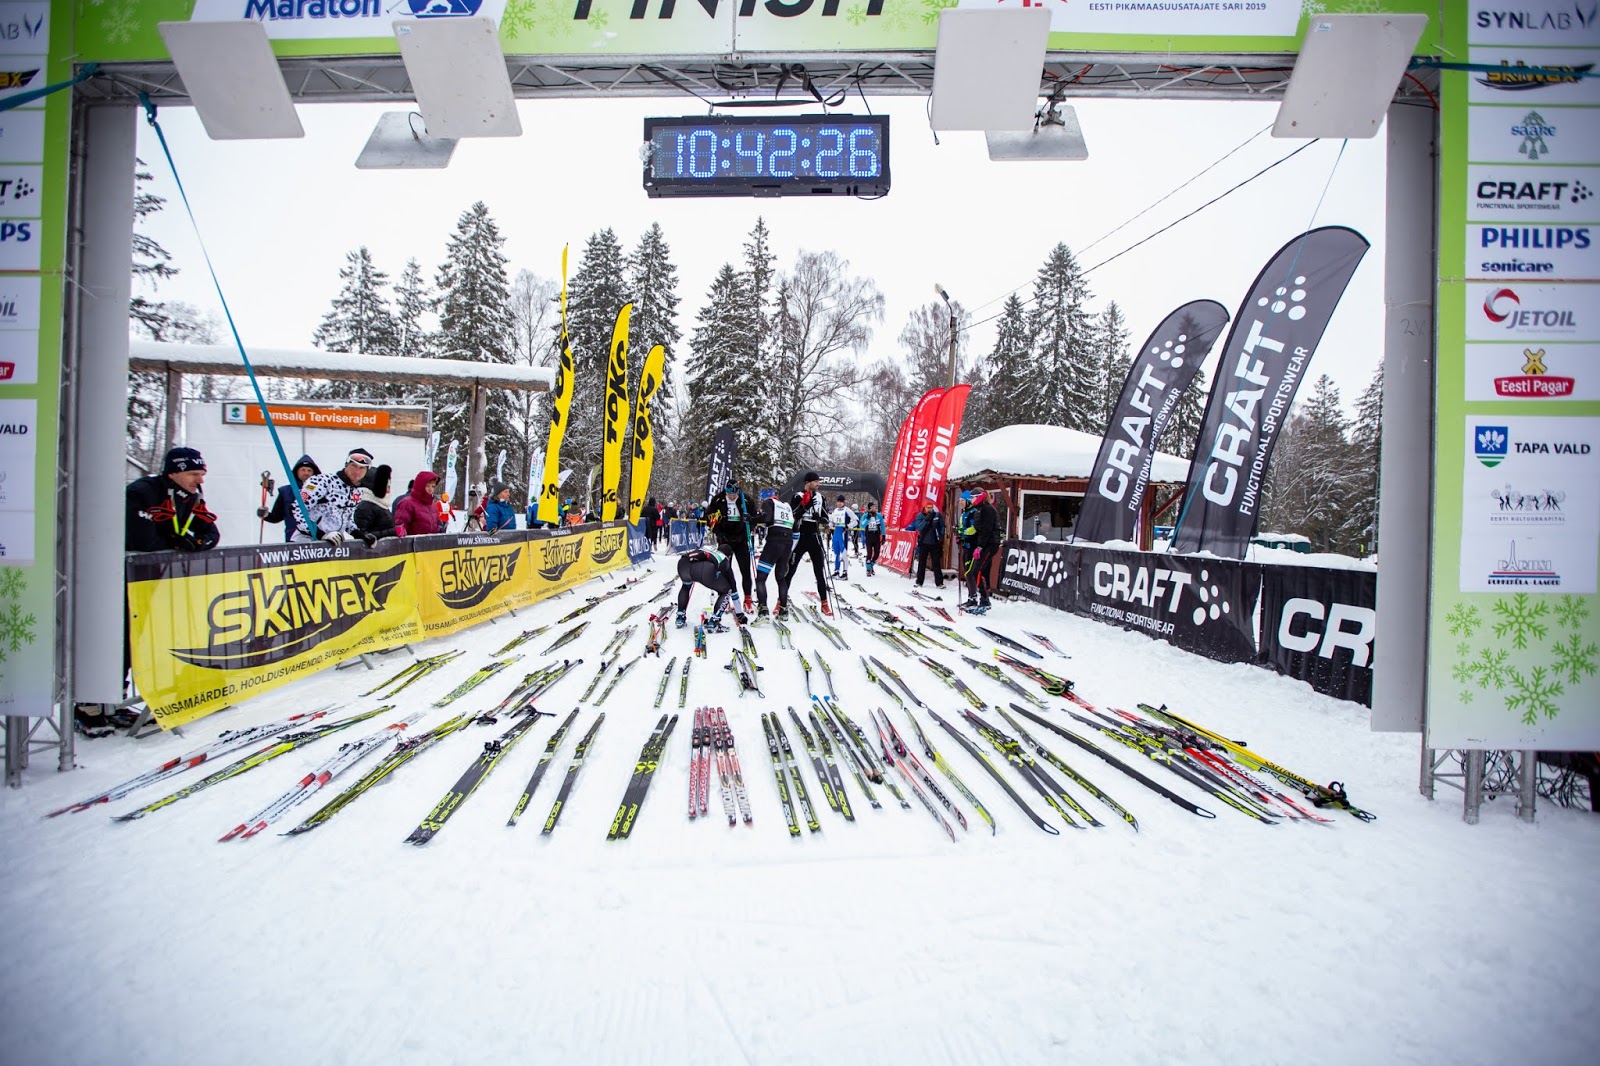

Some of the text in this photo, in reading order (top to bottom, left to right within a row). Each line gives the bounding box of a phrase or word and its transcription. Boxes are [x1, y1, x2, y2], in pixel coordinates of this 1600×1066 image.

[1089, 2, 1113, 11] EESTI
[1222, 2, 1244, 11] SARI
[1245, 2, 1267, 11] 2019
[1476, 11, 1571, 30] SYNLAB
[675, 129, 878, 178] 10:42:26
[1476, 181, 1569, 201] CRAFT
[1481, 228, 1591, 249] PHILIPS
[1481, 259, 1554, 273] sonicare
[1506, 310, 1577, 329] JETOIL
[1501, 380, 1569, 395] Eesti Pagar
[308, 411, 377, 425] Terviserajad
[1202, 320, 1286, 507] CRAFT
[1099, 364, 1167, 502] CRAFT
[1239, 346, 1309, 516] FUNCTIONAL SPORTSWEAR
[1515, 442, 1591, 454] TAPA VALD
[906, 427, 929, 500] e-kütus
[257, 546, 350, 564] www.skiwax.eu
[1004, 548, 1053, 582] CRAFT
[440, 550, 513, 594] skiwax
[1093, 561, 1192, 613] CRAFT
[208, 566, 387, 648] skiwax
[1091, 602, 1175, 635] FUNCTIONAL SPORTSWEAR
[609, 804, 627, 835] FISCHER
[621, 803, 638, 833] FISCHER
